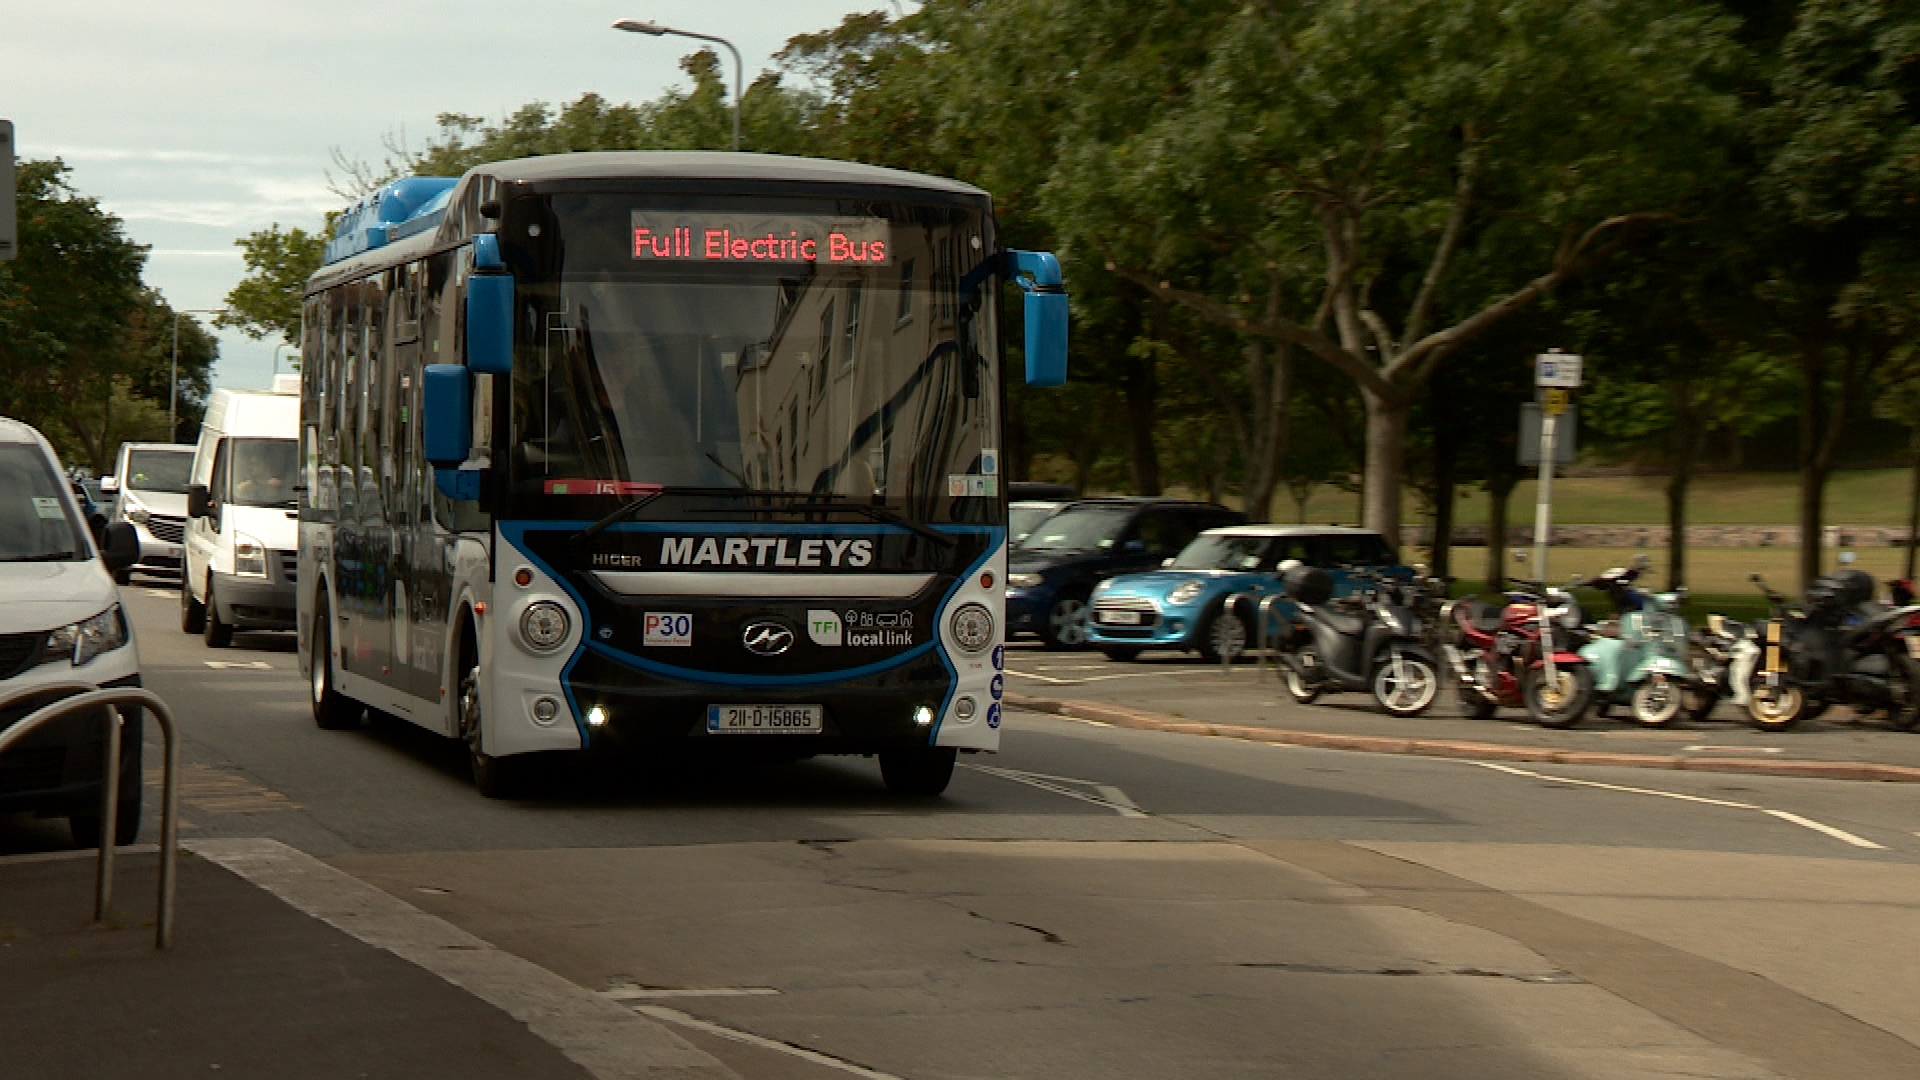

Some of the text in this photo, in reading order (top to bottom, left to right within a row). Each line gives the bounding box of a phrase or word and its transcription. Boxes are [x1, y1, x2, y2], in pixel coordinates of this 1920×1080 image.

[634, 228, 885, 261] Full Electric Bus
[592, 553, 642, 567] HIGER
[660, 537, 872, 567] MARTLEYS
[645, 615, 690, 636] P30
[812, 621, 838, 634] TFI
[728, 709, 811, 726] 211-D-15865
